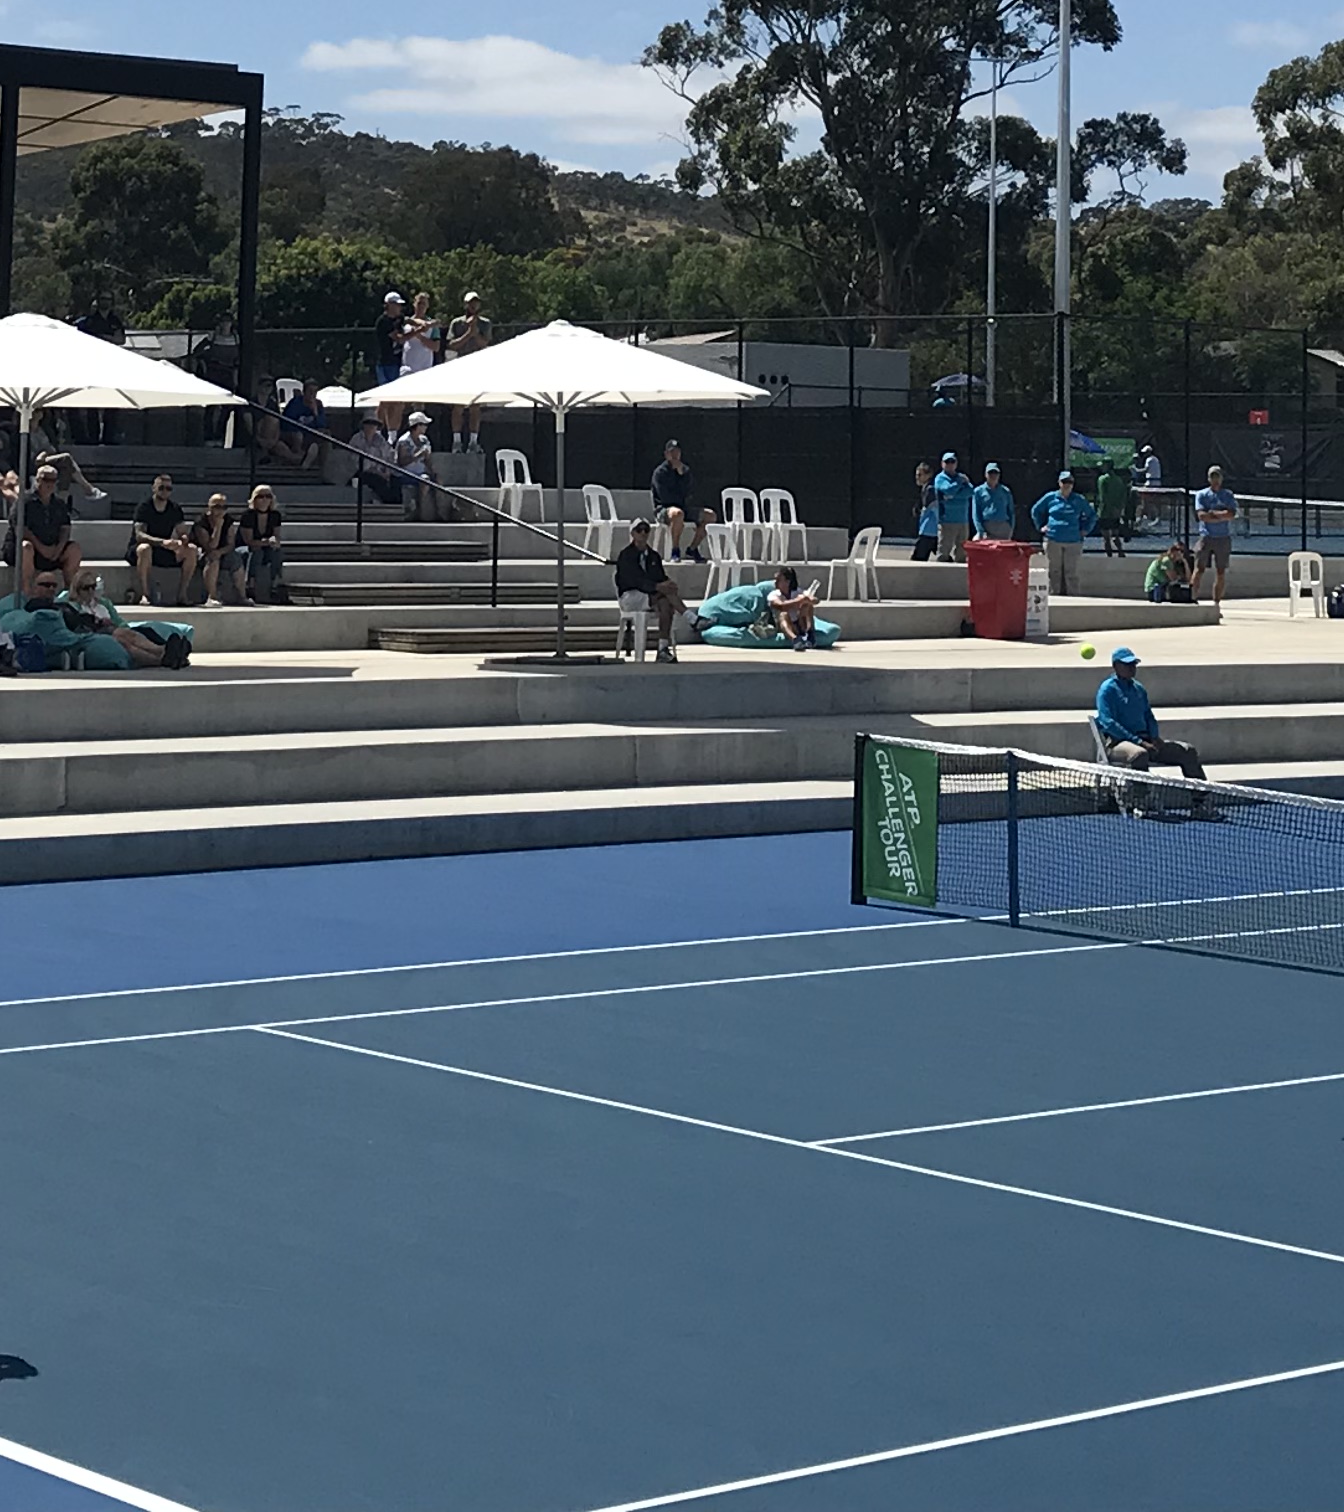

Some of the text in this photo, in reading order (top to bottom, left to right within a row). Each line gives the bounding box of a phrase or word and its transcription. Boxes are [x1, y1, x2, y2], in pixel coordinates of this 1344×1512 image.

[875, 749, 918, 897] CHALLENGER
[898, 772, 921, 829] ATP
[877, 816, 901, 878] TOUR
